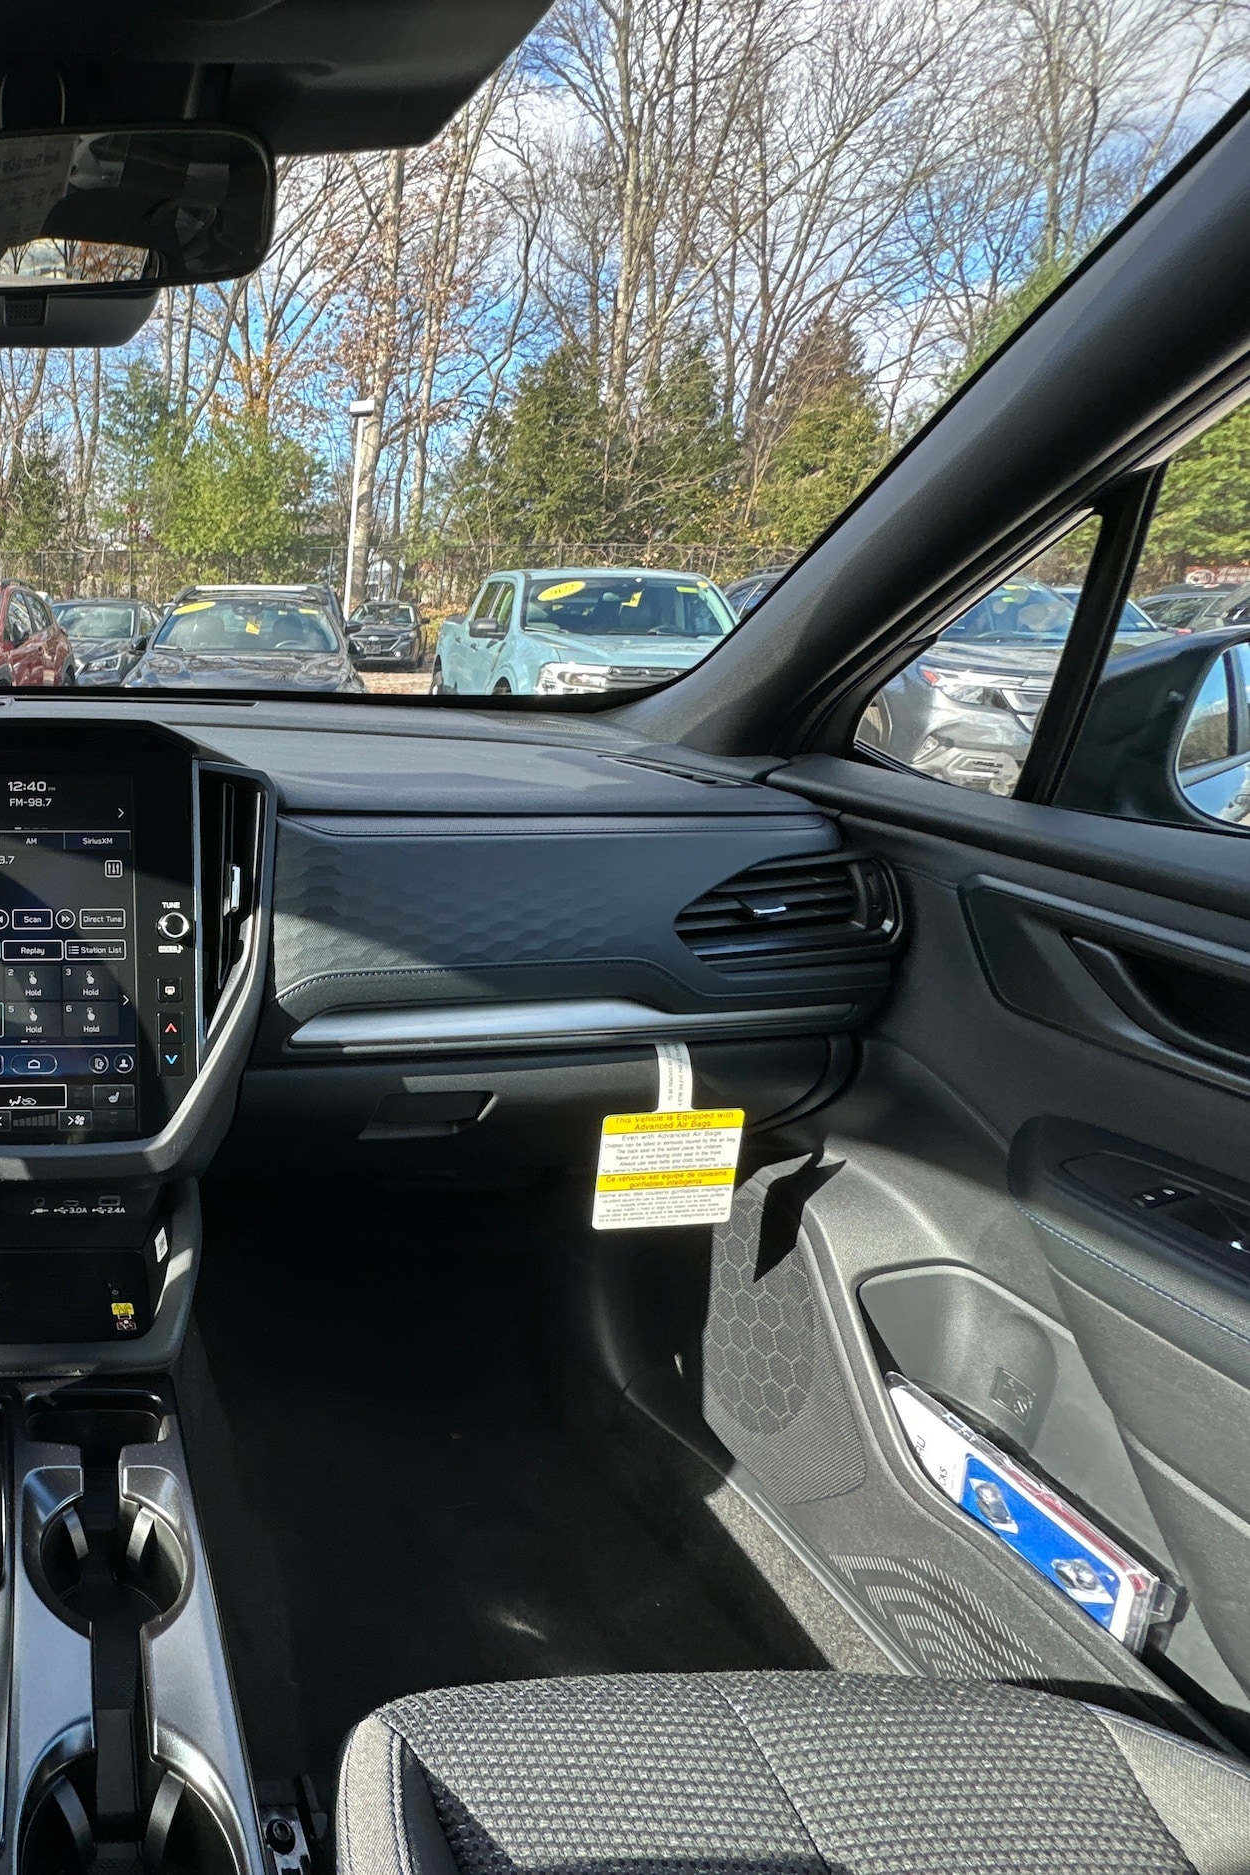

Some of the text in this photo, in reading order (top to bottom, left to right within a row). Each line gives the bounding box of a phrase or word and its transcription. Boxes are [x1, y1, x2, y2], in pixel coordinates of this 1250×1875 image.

[7, 781, 47, 792] 12:40
[9, 797, 52, 807] FM-98.7
[25, 837, 38, 845] AM
[82, 836, 114, 846] SiriusXM
[23, 916, 42, 924] Scan
[83, 915, 122, 924] Direct Tune
[20, 946, 46, 956] Replay
[80, 946, 122, 954] Station List
[65, 968, 72, 976] 3
[82, 988, 99, 996] Hold
[634, 1114, 664, 1123] Vehicle
[666, 1114, 674, 1122] is
[677, 1112, 714, 1122] Equipped
[634, 1120, 712, 1131] Advanced Air Bags
[658, 1132, 690, 1140] Advanced
[704, 1130, 722, 1138] Bags
[630, 1178, 702, 1189] gonflables intelligents
